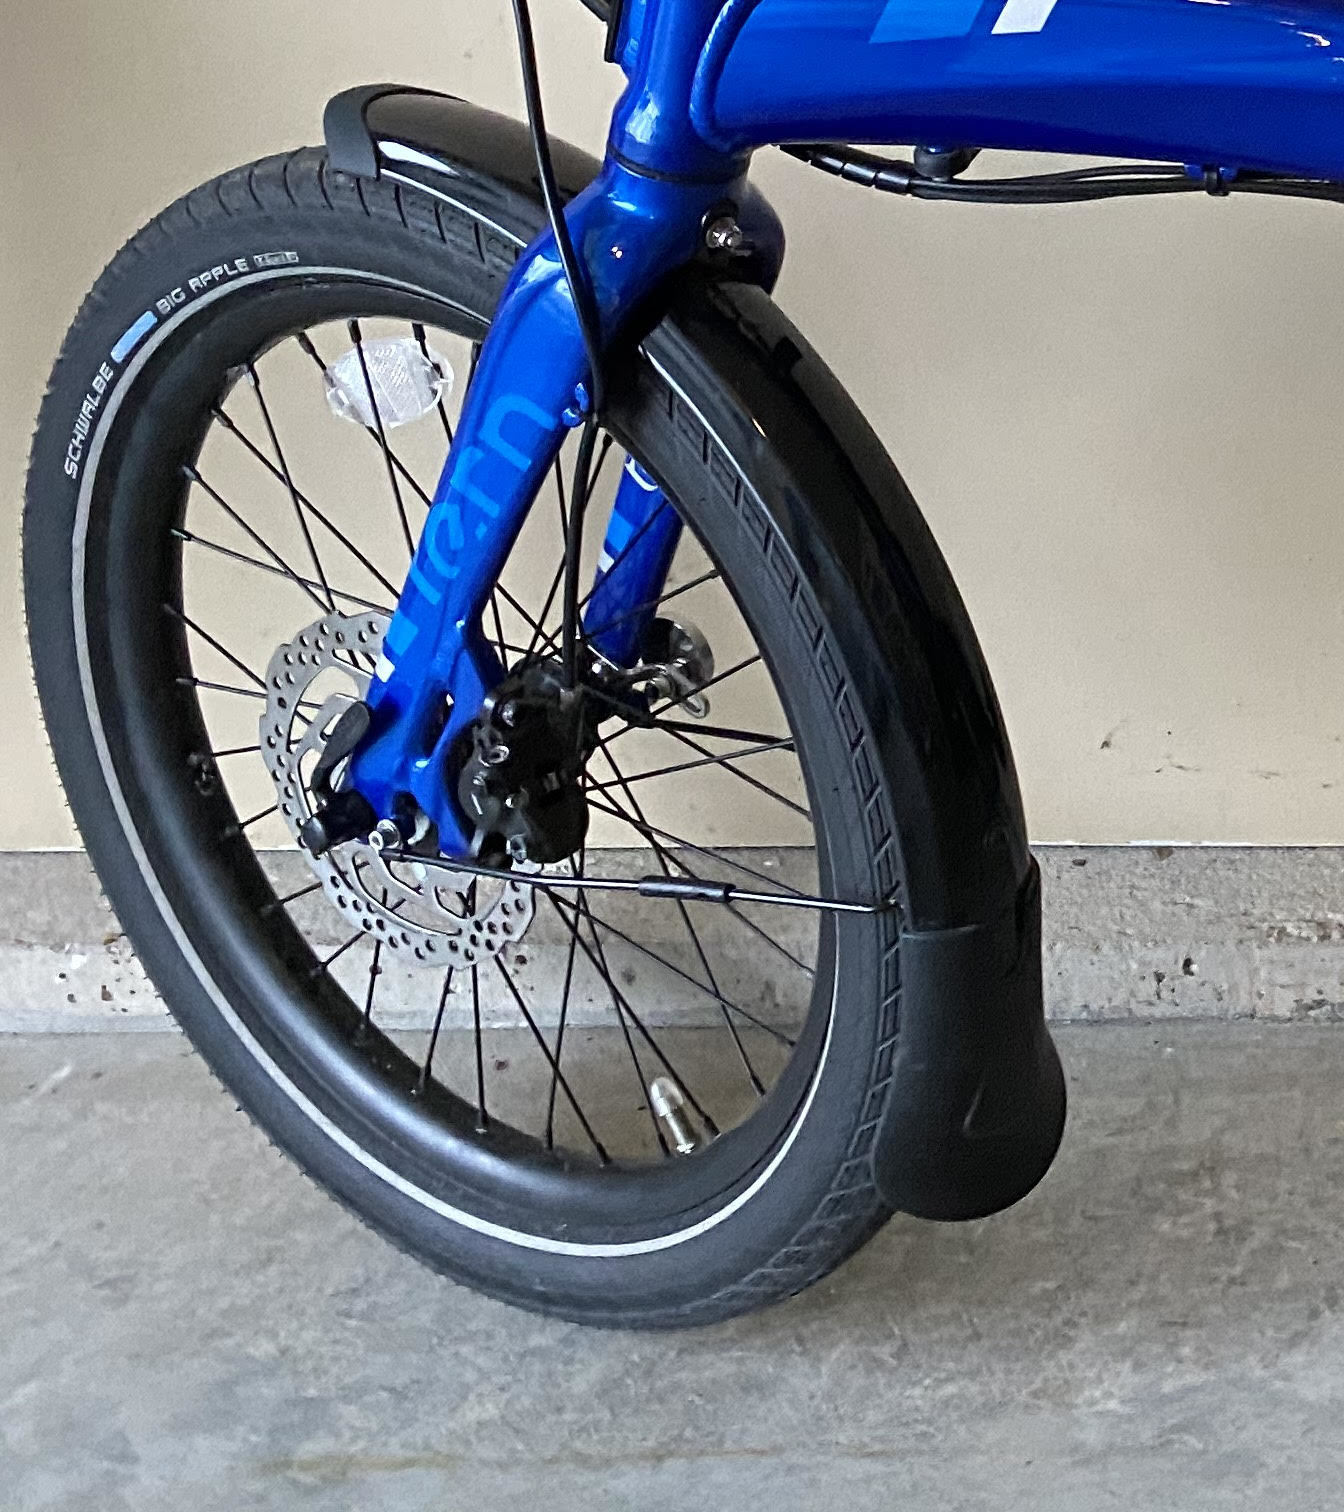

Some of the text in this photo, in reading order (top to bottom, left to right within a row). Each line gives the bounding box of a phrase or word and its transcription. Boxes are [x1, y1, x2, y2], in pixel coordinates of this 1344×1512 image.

[64, 258, 250, 480] SCHWALBE BIG APPLE
